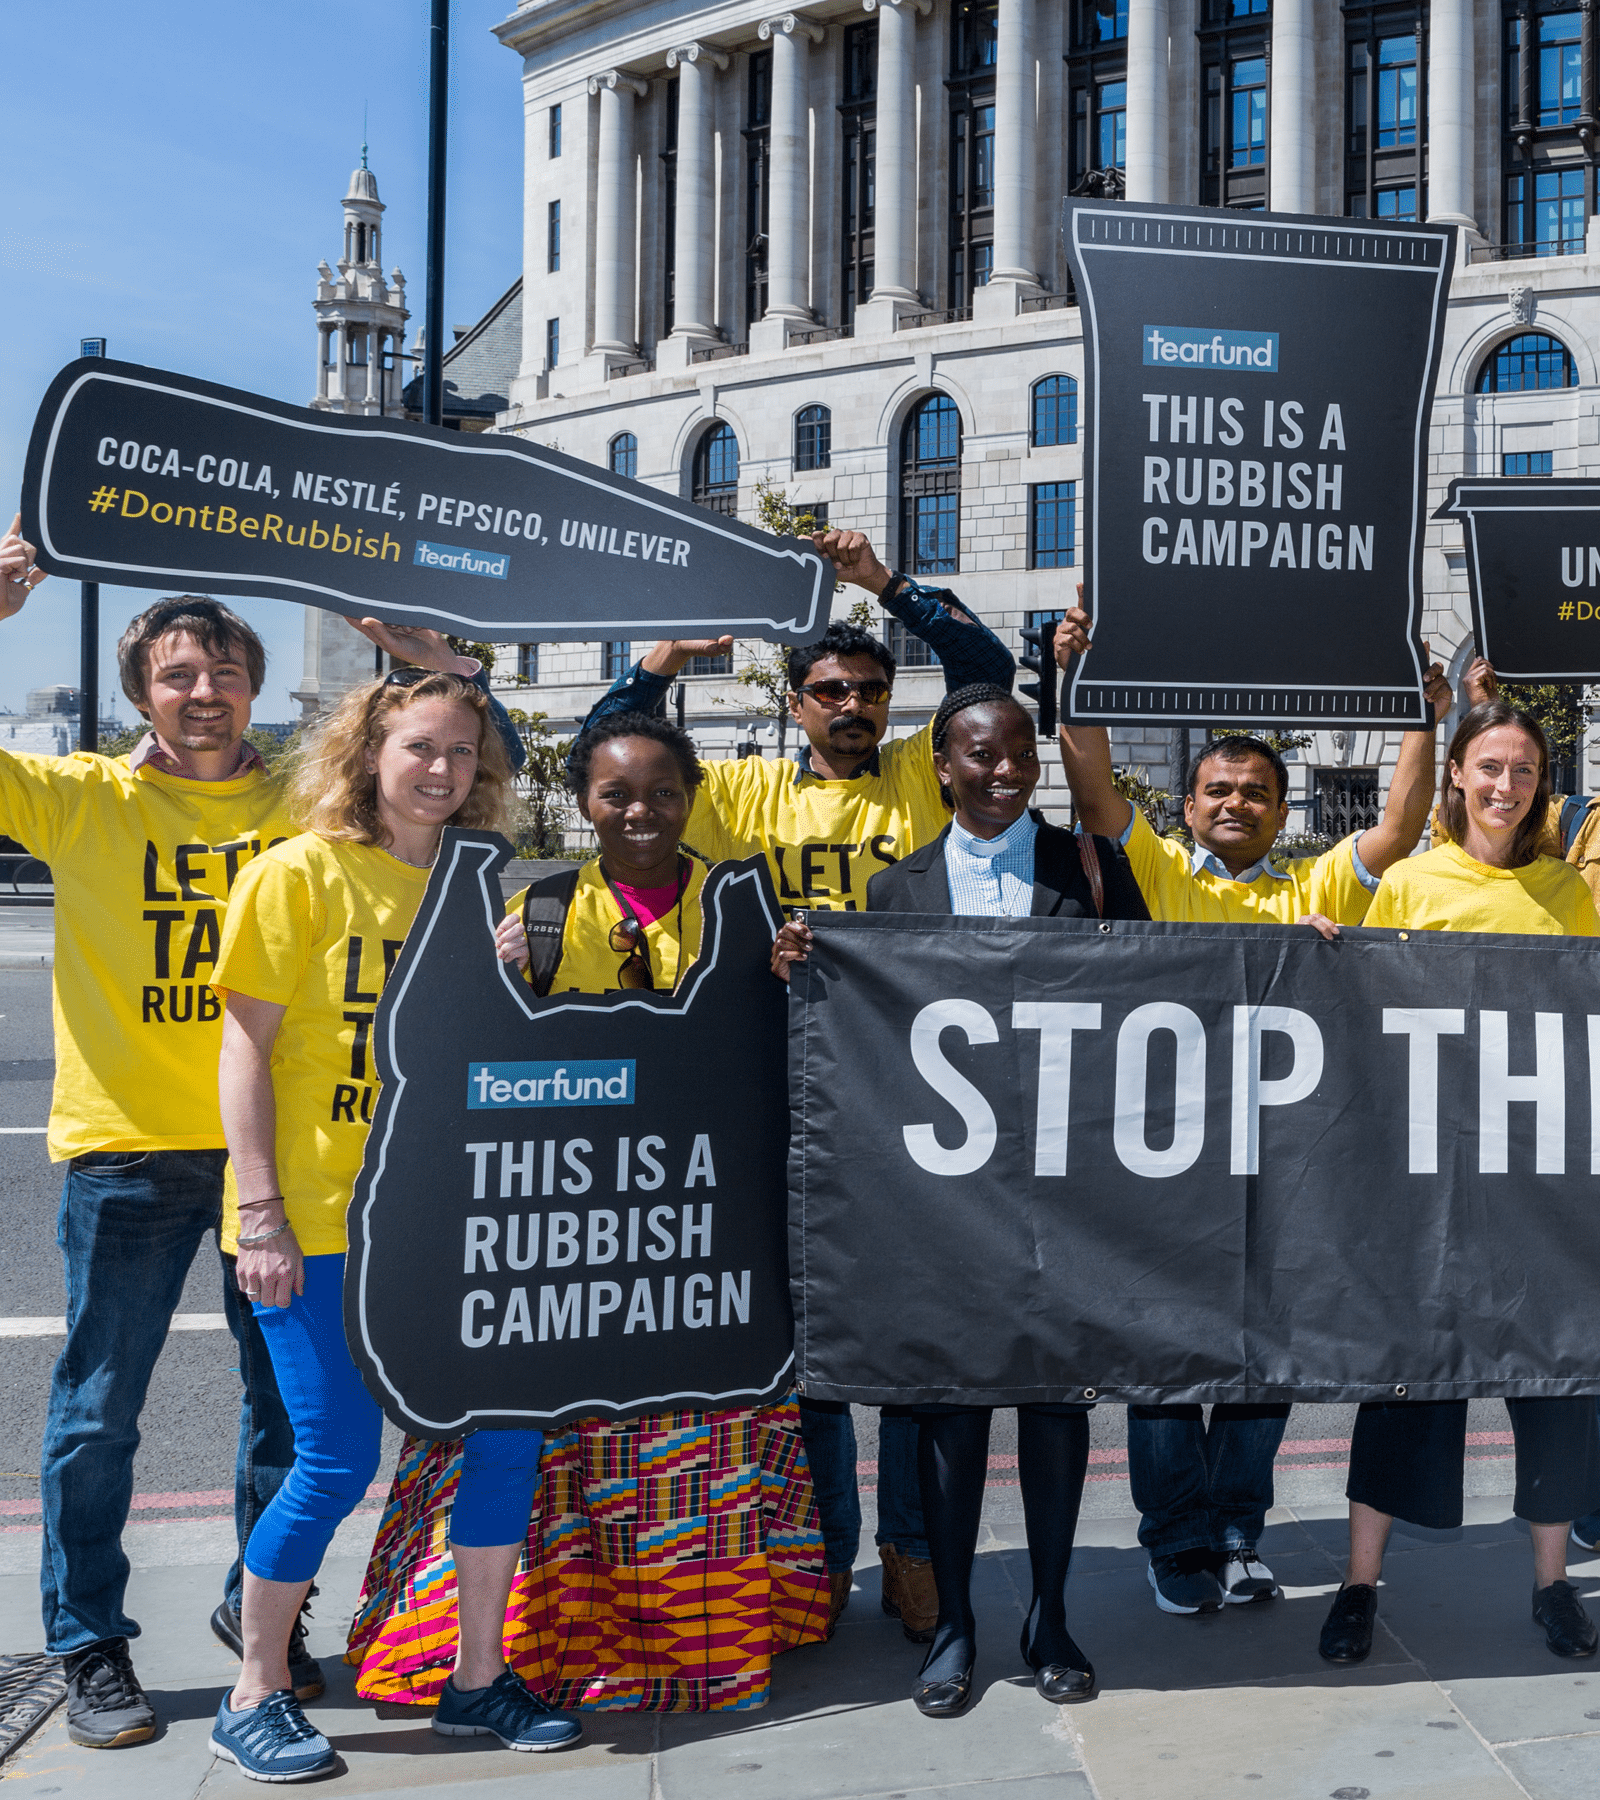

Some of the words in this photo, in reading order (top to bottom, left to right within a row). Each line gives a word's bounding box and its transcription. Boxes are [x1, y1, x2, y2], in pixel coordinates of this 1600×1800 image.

[1147, 329, 1273, 367] tearfund
[1142, 393, 1245, 446] THIS
[1263, 399, 1305, 449] IS
[1318, 403, 1346, 451] A
[97, 436, 280, 500] COCA-COLA,
[291, 470, 406, 522] NESTLÉ,
[417, 493, 549, 547] PEPSICO,
[559, 518, 691, 568] UNILEVER
[1143, 455, 1343, 511] RUBBISH
[88, 485, 401, 562] #DontBeRubbish
[1142, 516, 1375, 571] CAMPAIGN
[417, 542, 508, 578] tearfund
[143, 839, 289, 901] LET'
[473, 1067, 628, 1103] tearfund
[902, 998, 1325, 1179] STOP
[465, 1138, 594, 1199] THIS
[616, 1135, 666, 1192] IS
[684, 1133, 717, 1188] A
[463, 1203, 713, 1274] RUBBISH
[460, 1270, 751, 1348] CAMPAIGN
